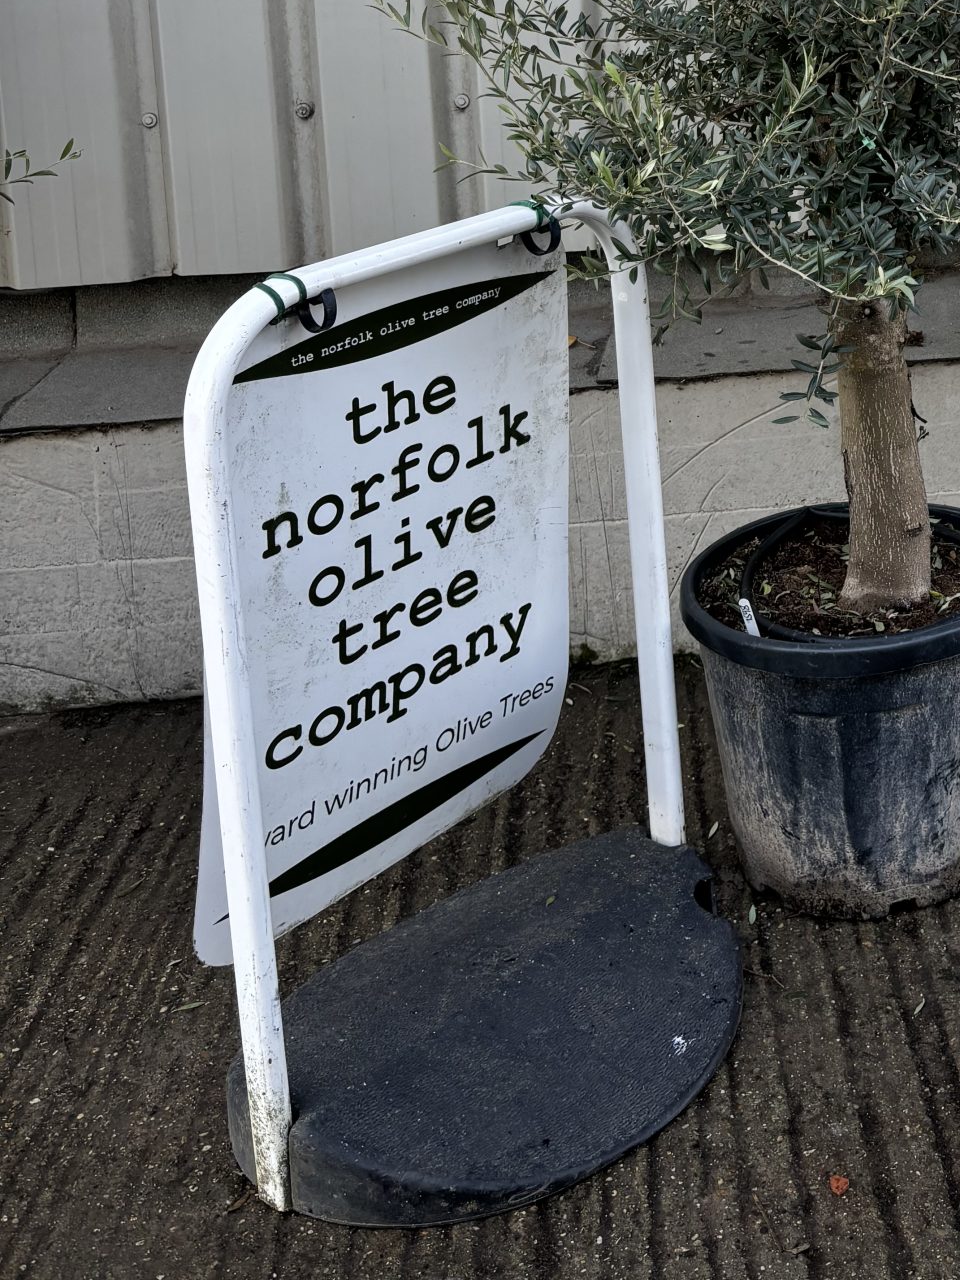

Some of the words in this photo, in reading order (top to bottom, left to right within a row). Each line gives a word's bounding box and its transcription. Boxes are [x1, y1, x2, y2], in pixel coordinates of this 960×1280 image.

[290, 351, 315, 368] the
[321, 330, 374, 358] norfolk
[379, 317, 416, 337] olive
[422, 304, 450, 322] tree
[455, 285, 502, 311] company
[346, 375, 457, 446] the
[262, 403, 532, 560] norfolk
[308, 496, 496, 607] olive
[332, 570, 479, 665] tree
[265, 603, 532, 770] company
[264, 800, 316, 848] ard
[324, 745, 429, 816] winning
[435, 710, 493, 754] Olive
[499, 675, 555, 718] Trees
